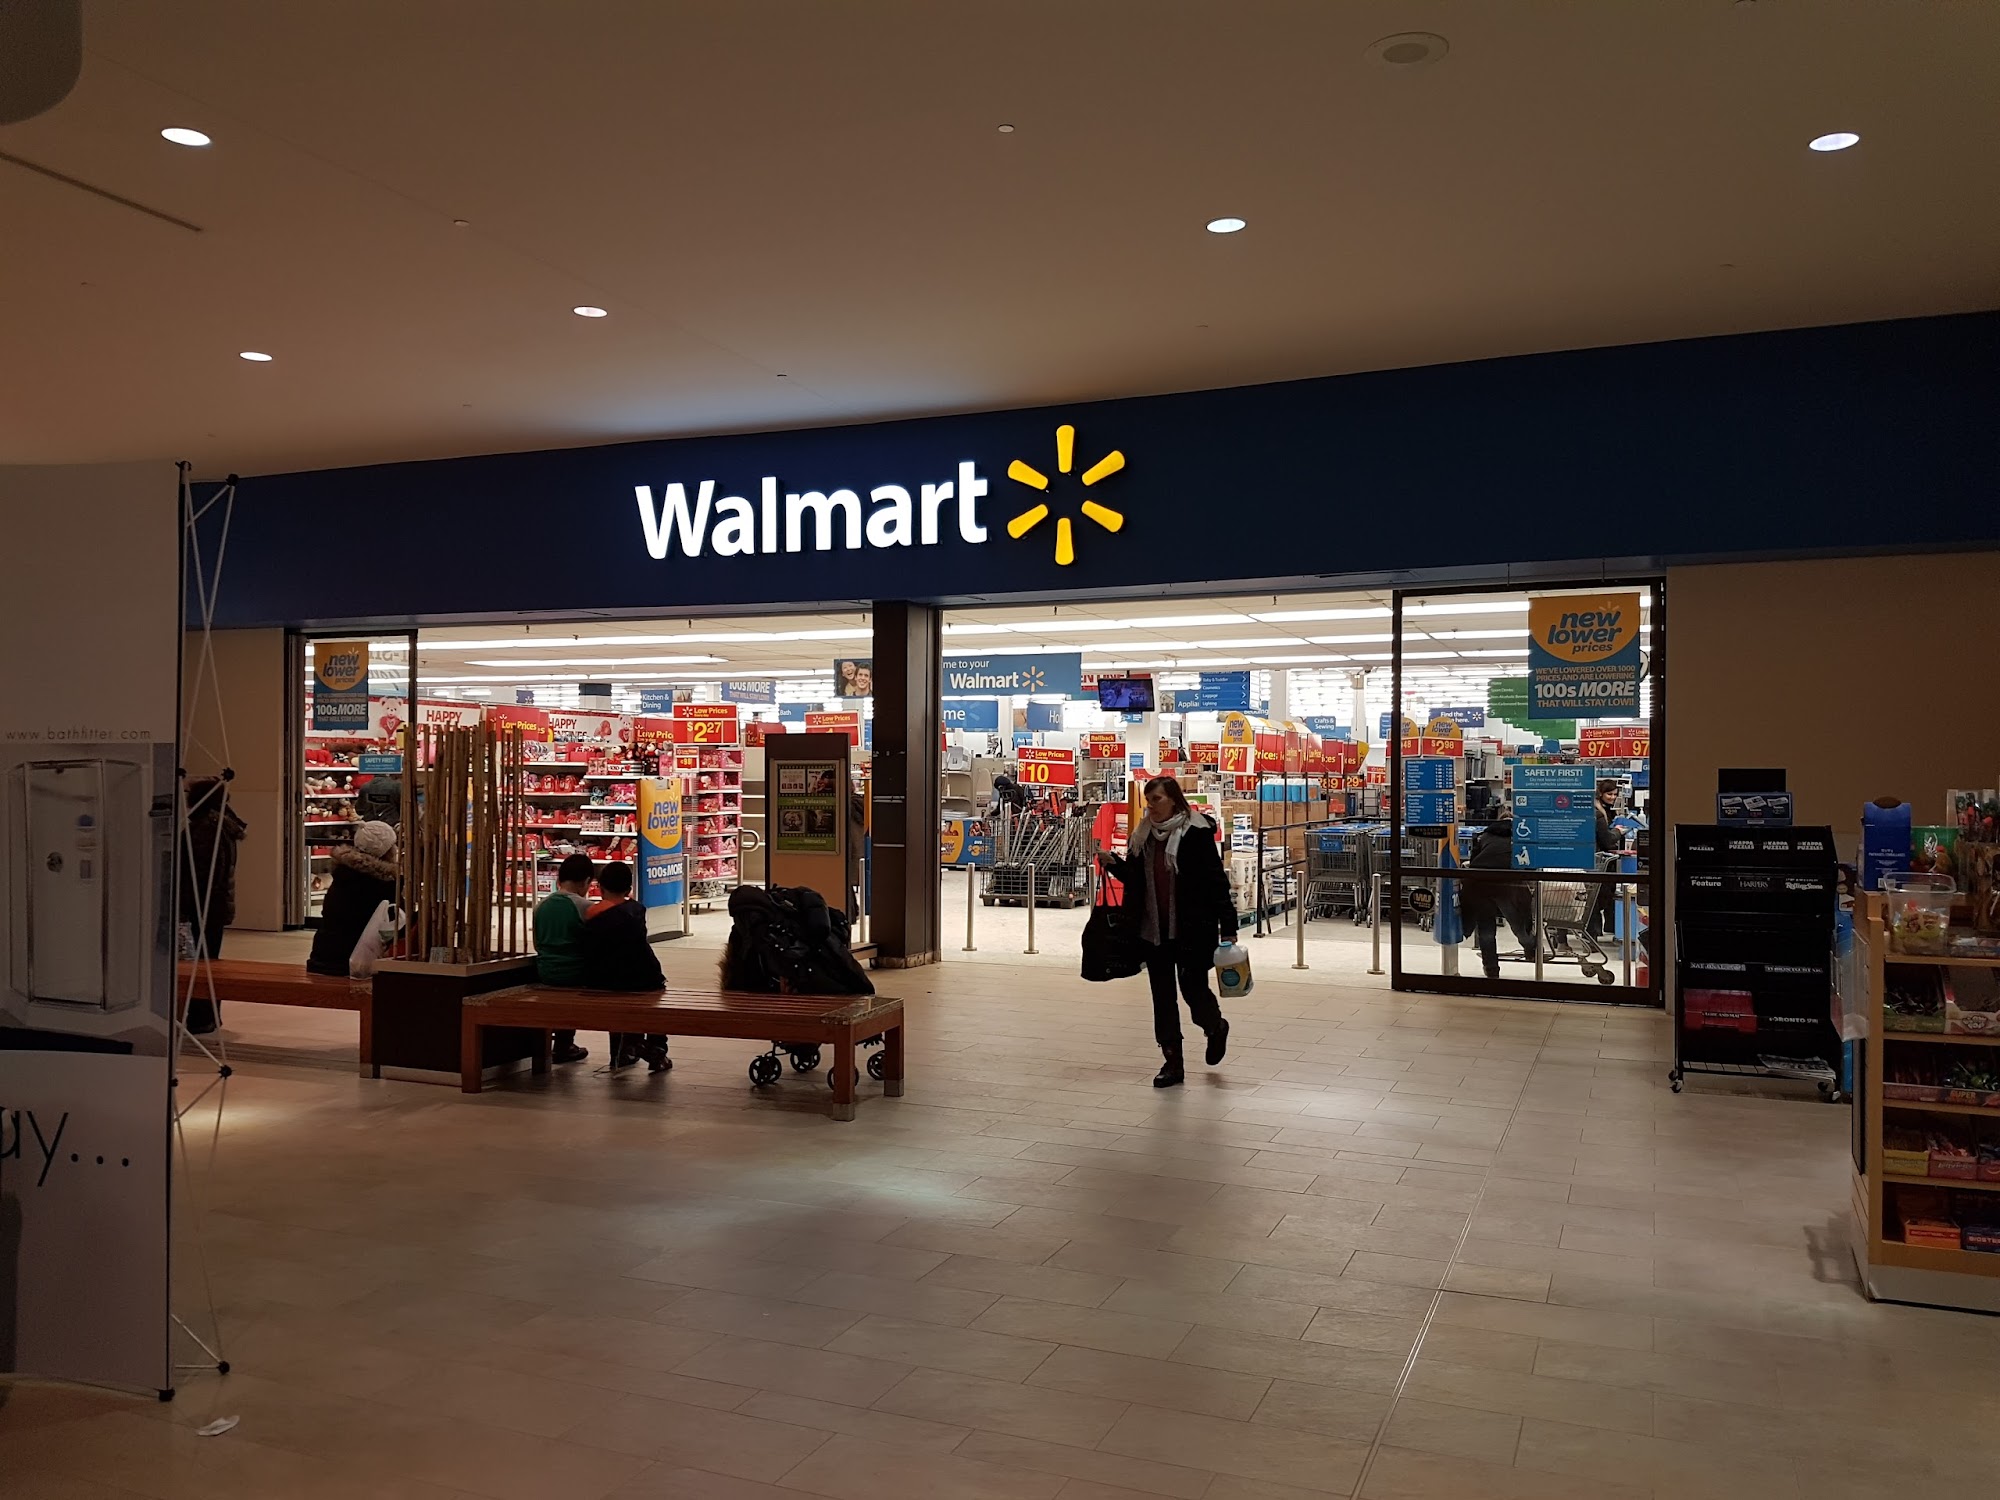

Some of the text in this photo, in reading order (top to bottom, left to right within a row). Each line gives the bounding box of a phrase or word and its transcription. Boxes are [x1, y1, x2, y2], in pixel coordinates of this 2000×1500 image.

[634, 461, 989, 560] Walmart
[1560, 611, 1621, 628] new
[1547, 624, 1622, 645] lower
[1572, 643, 1613, 655] prices
[329, 654, 360, 666] new
[958, 660, 968, 668] to
[970, 660, 990, 670] your
[323, 663, 360, 677] lower
[1536, 667, 1559, 675] WE'VE
[1559, 666, 1596, 674] LOWERED
[1596, 665, 1617, 673] OVER
[949, 671, 1019, 689] Walmart
[1536, 674, 1561, 682] PRICES
[1595, 672, 1635, 680] LOWERING
[747, 682, 770, 693] MORE
[1534, 681, 1636, 698] 100s MORE
[643, 693, 670, 701] Kitchen &
[643, 702, 662, 710] Dining
[1537, 699, 1560, 708] THAT
[1562, 699, 1583, 707] WILL
[1584, 698, 1607, 706] STAY
[315, 703, 367, 716] 100s MORE
[426, 709, 462, 722] HAPPY
[517, 721, 537, 730] Prices
[1230, 719, 1245, 728] new
[637, 730, 656, 738] Low
[1227, 726, 1245, 737] lower
[1048, 750, 1065, 758] Prices
[1524, 768, 1583, 777] SAFETY FIRST!
[653, 800, 679, 814] new
[647, 813, 680, 830] lower
[660, 828, 679, 838] prices
[646, 866, 667, 879] 100s
[1691, 879, 1722, 887] Feature
